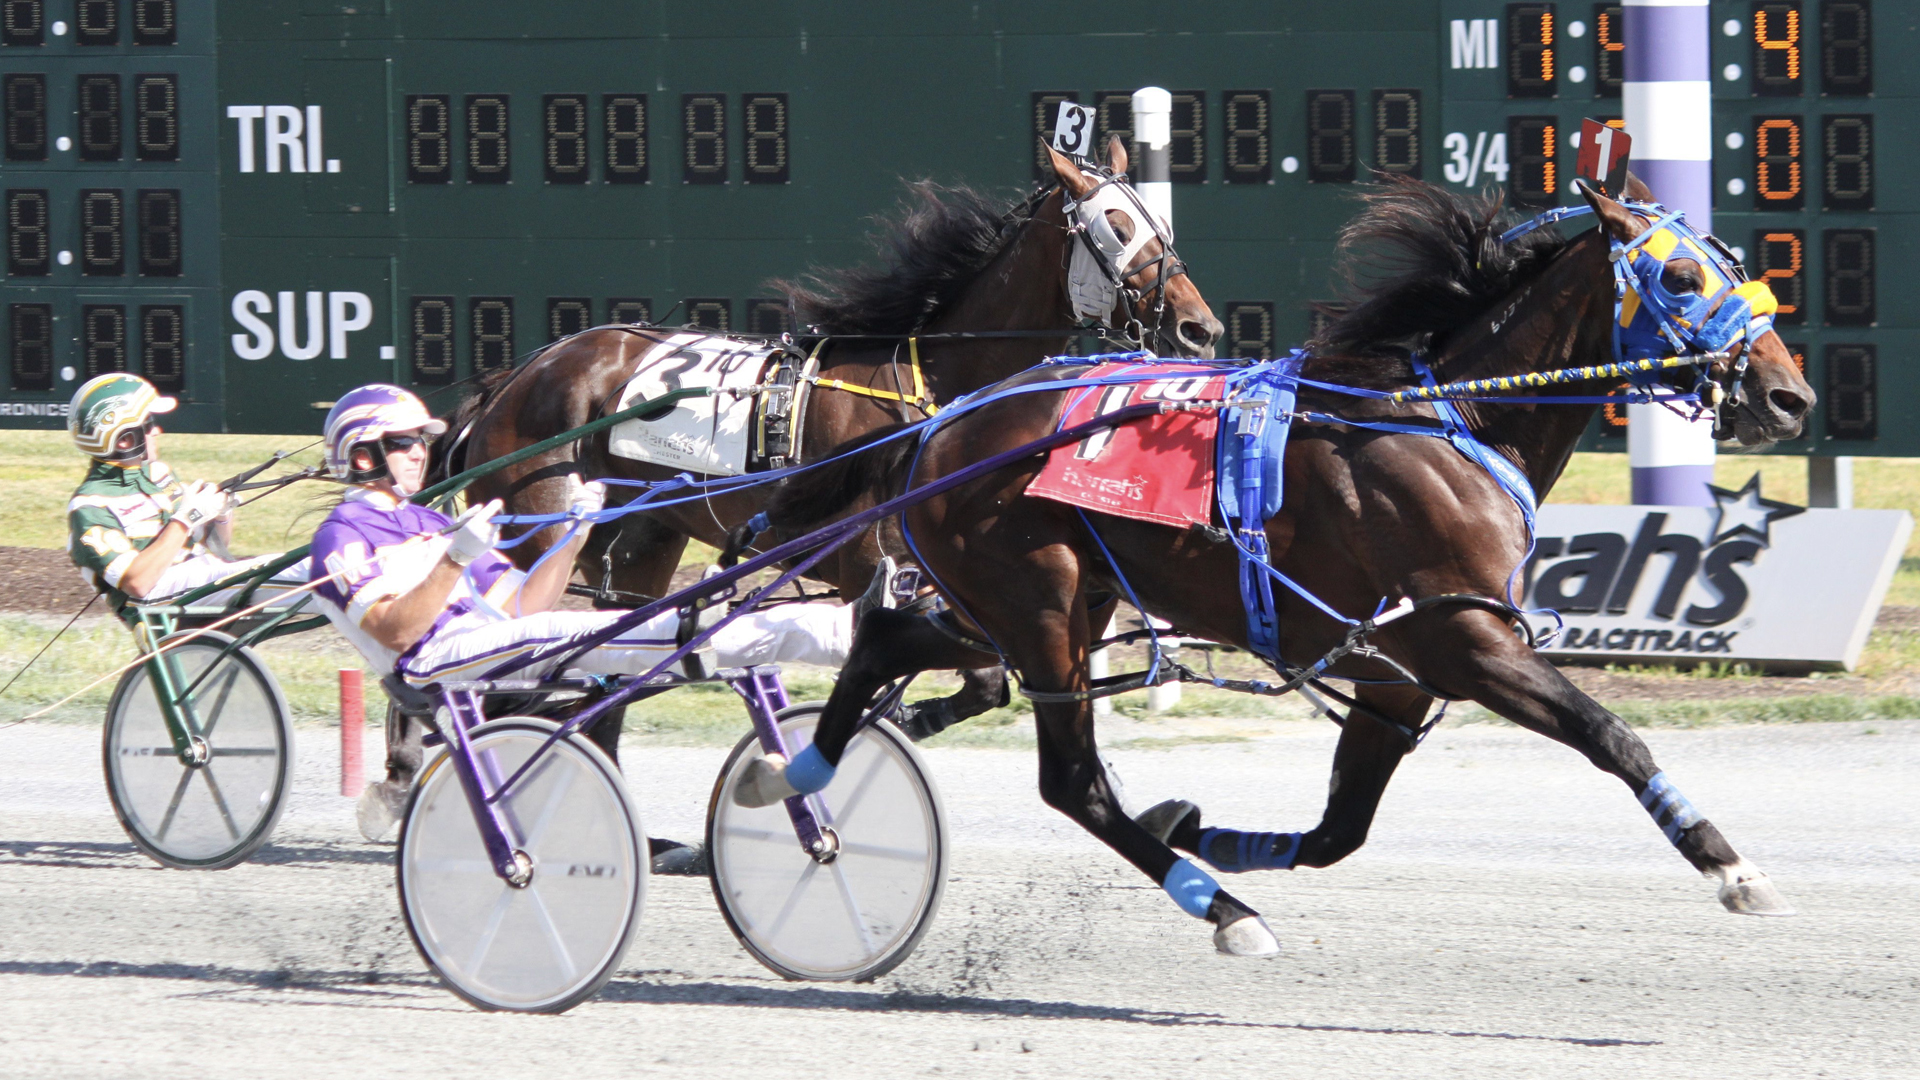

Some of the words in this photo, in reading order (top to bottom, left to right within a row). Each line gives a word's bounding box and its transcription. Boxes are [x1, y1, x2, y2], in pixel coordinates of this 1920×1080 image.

[1450, 19, 1498, 70] MI
[227, 105, 341, 173] TRI.
[1059, 105, 1087, 153] 3
[1594, 126, 1613, 182] 1
[1443, 132, 1510, 188] 3/4
[231, 289, 396, 360] SUP.
[0, 403, 70, 416] RONICS
[1562, 627, 1738, 654] RACETRACK
